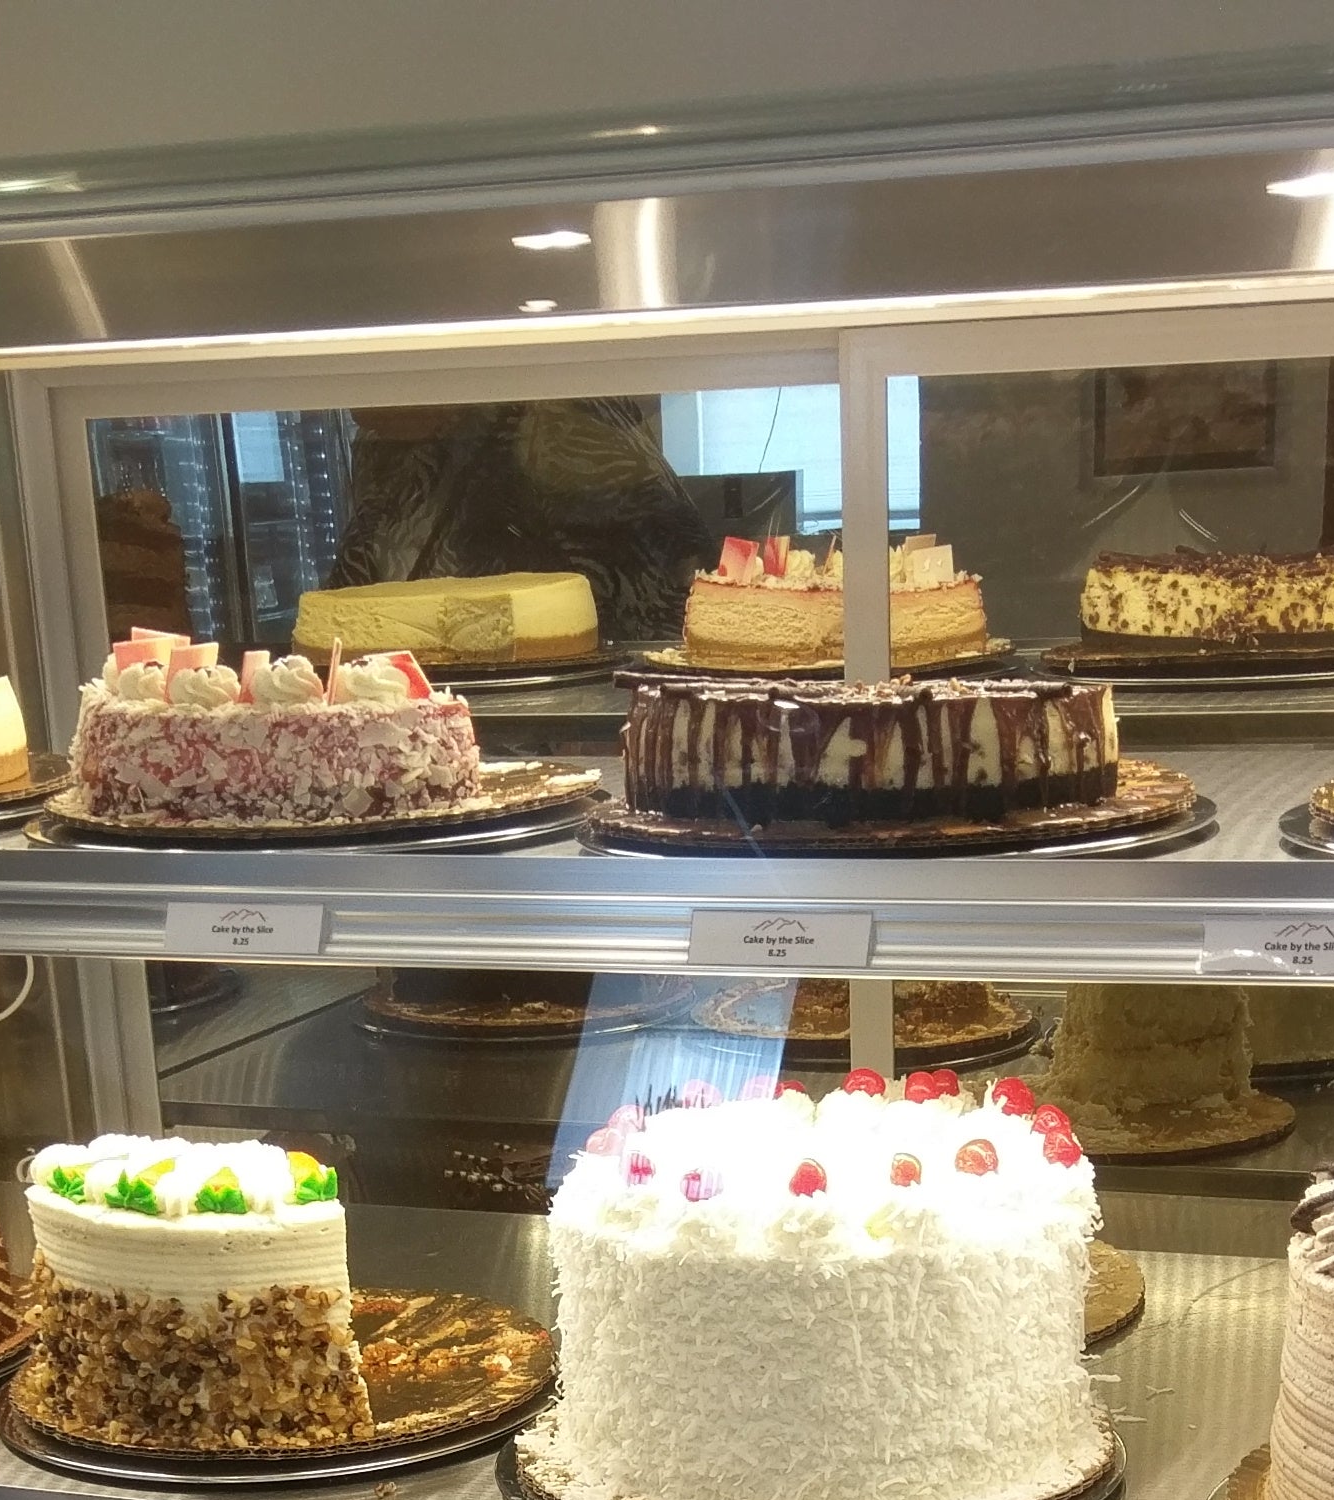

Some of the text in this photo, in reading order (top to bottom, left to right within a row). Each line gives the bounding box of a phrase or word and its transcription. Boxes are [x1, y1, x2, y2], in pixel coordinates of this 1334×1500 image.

[211, 925, 274, 935] Cake by the Slice
[232, 937, 249, 946] 8.25
[743, 935, 815, 946] Cake by the Slice
[1264, 942, 1288, 951] Cake
[1290, 942, 1302, 952] by
[1304, 943, 1321, 951] the
[768, 949, 787, 957] 8.25
[1292, 956, 1313, 965] 8.25
